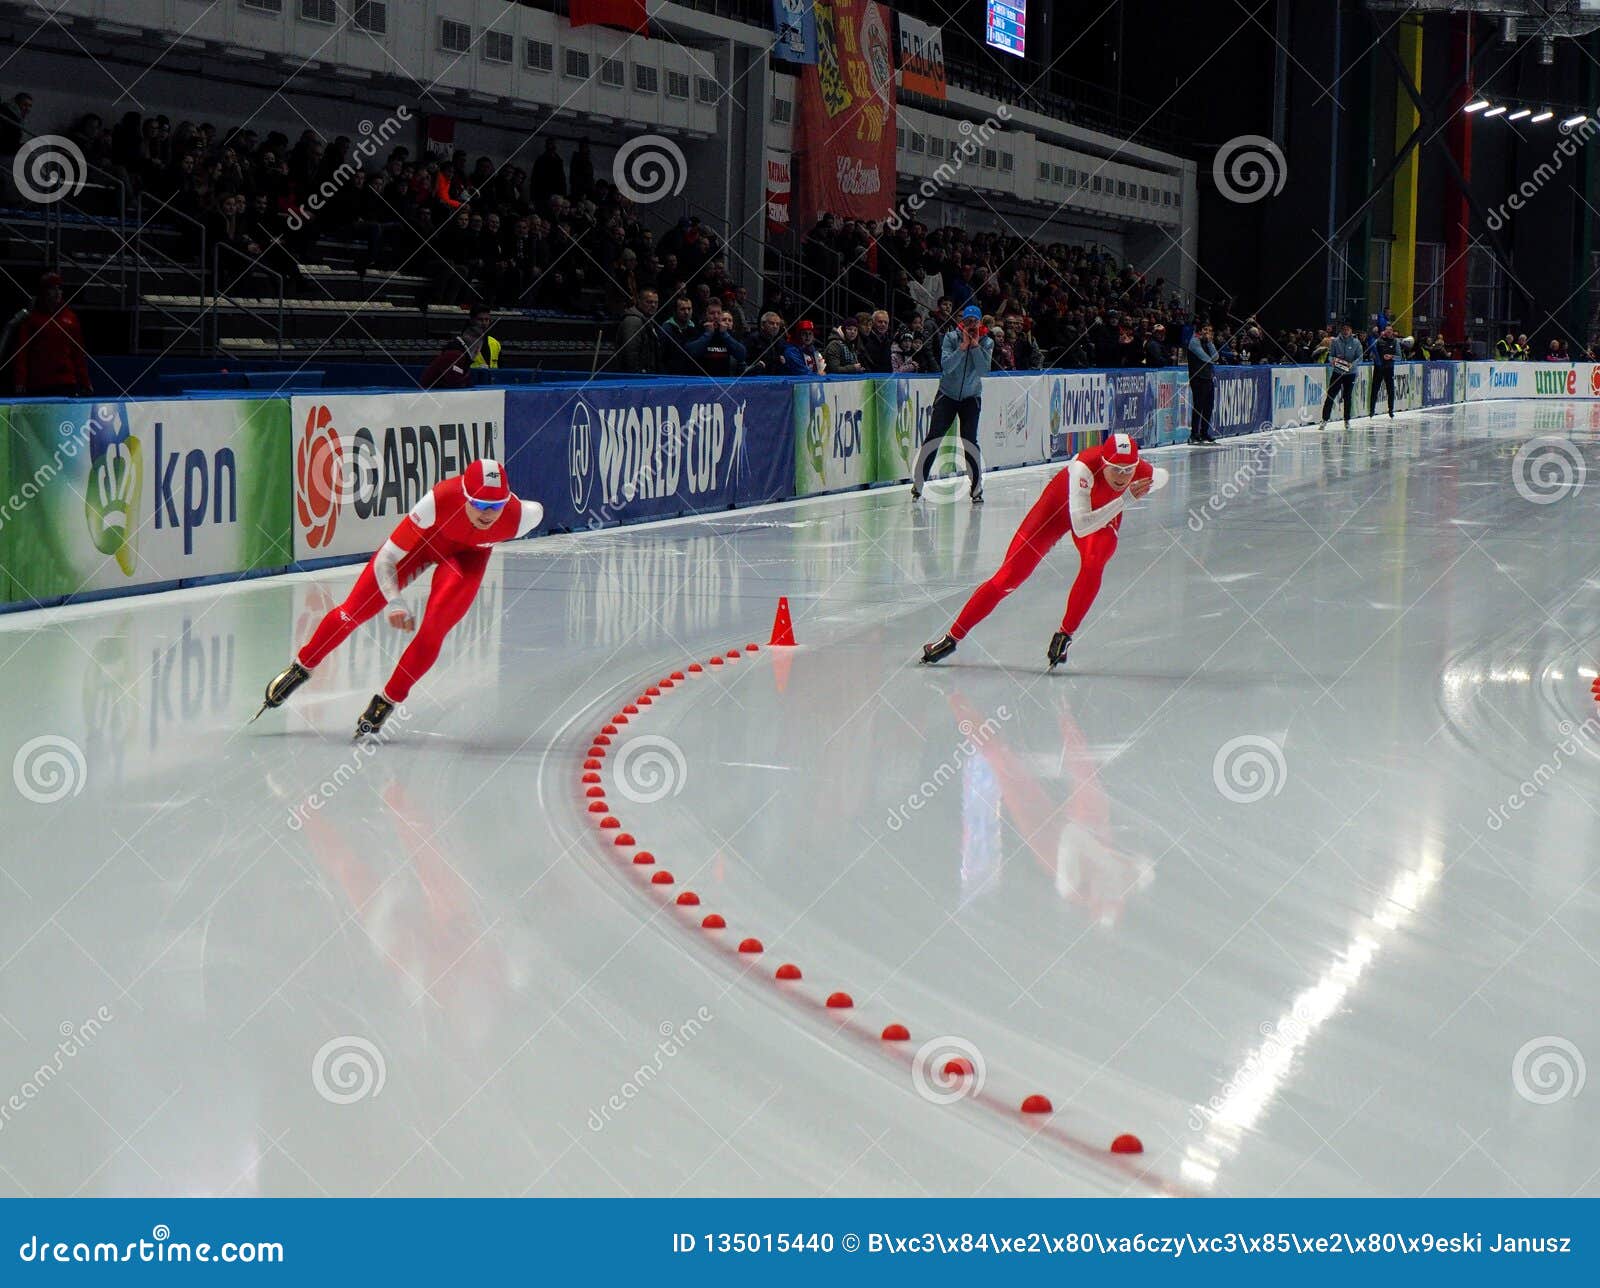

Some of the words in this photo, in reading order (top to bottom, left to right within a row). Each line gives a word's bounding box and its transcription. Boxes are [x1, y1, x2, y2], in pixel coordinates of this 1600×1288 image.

[1494, 371, 1518, 388] DAIKIN
[1535, 362, 1577, 395] univé
[598, 405, 682, 504] WORLD
[686, 402, 725, 494] CUP
[154, 422, 237, 555] kpn
